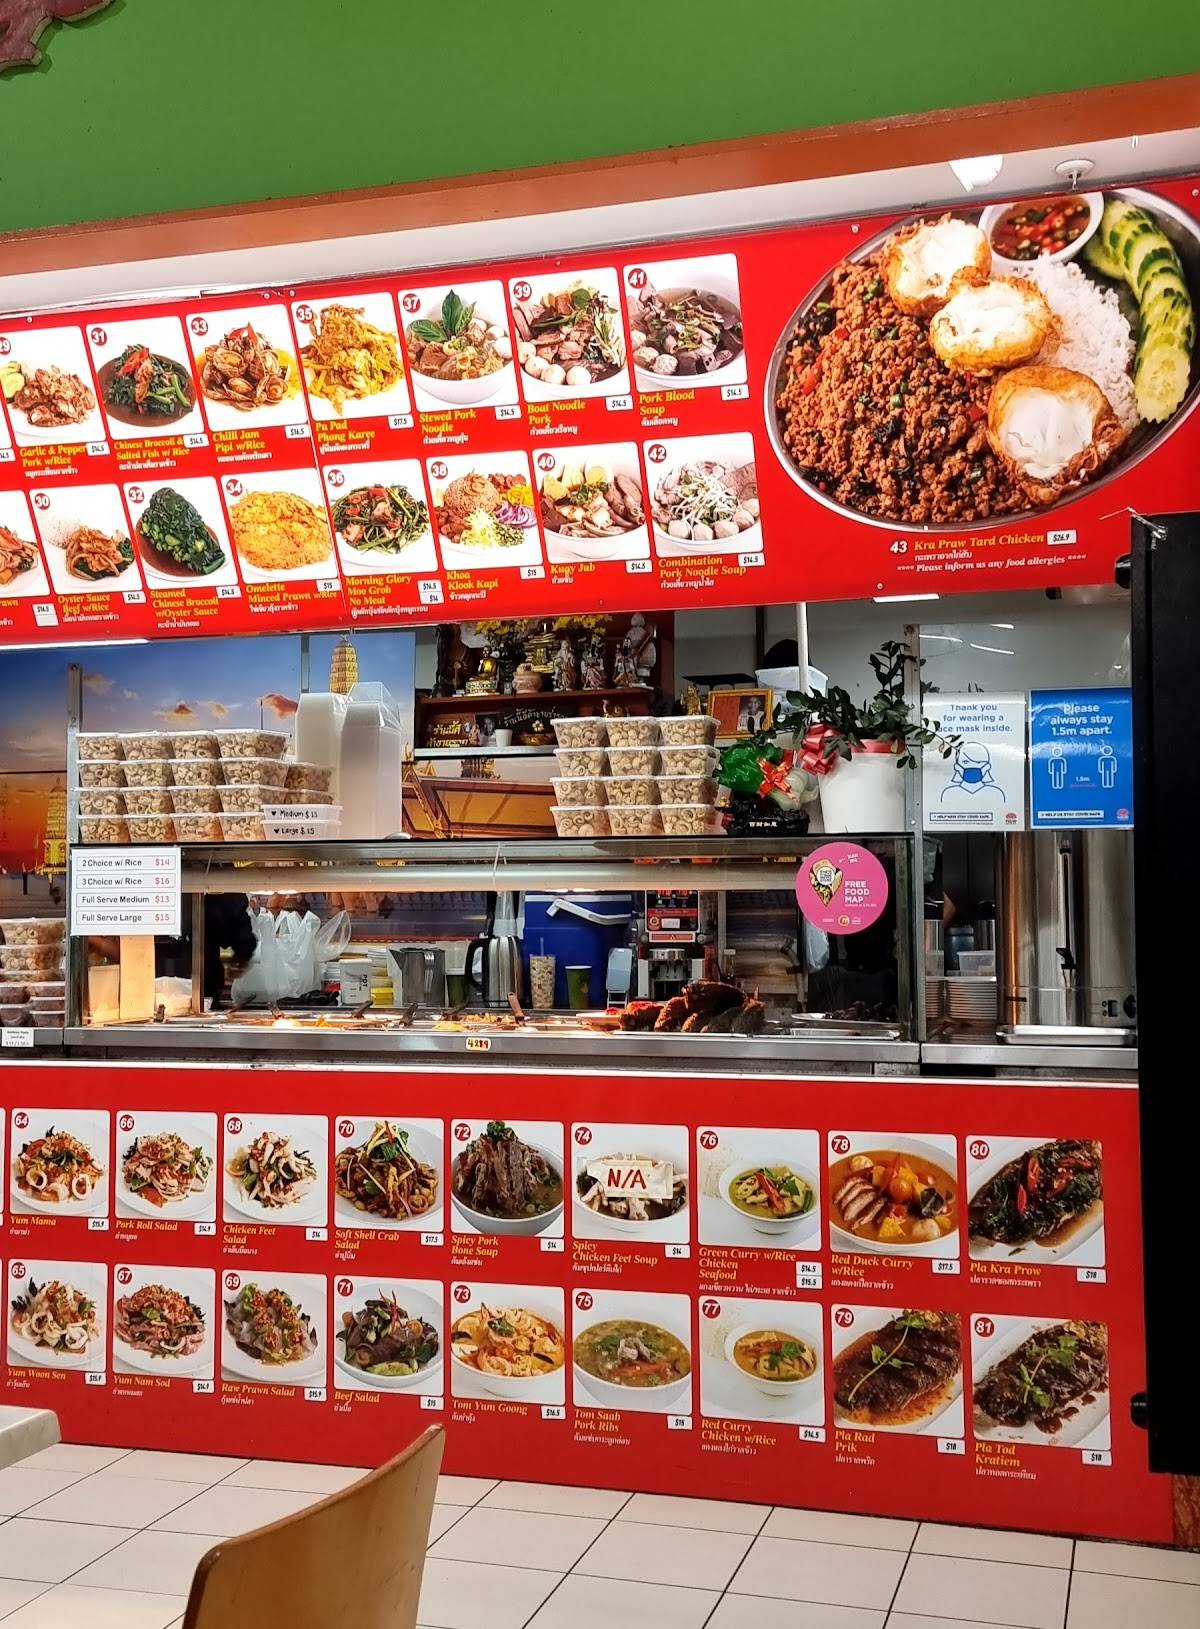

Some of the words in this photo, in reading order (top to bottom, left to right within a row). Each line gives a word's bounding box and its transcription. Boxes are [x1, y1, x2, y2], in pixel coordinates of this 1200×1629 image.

[628, 272, 644, 284] 41
[514, 285, 531, 297] 39
[403, 297, 420, 310] 37
[297, 308, 312, 321] 35
[193, 321, 207, 332] 33
[92, 331, 105, 342] 31
[639, 392, 663, 403] Pork
[665, 390, 695, 401] Blood
[528, 403, 551, 413] Boat
[552, 400, 586, 411] Noodle
[640, 405, 665, 416] Soup
[420, 413, 451, 423] Stewed
[454, 410, 476, 420] Pork
[529, 415, 552, 425] Pork
[316, 422, 327, 432] Pu
[330, 420, 347, 430] Pad
[422, 424, 453, 434] Noodle
[212, 431, 236, 442] Chilli
[239, 429, 260, 440] Jam
[318, 432, 346, 443] Phong
[348, 430, 375, 441] Karee
[215, 443, 233, 453] Pipi
[236, 440, 265, 450] w/Rice
[649, 446, 665, 459] 42
[538, 457, 554, 468] 40
[432, 465, 447, 475] 38
[329, 473, 343, 484] 36
[227, 482, 242, 493] 34
[129, 490, 144, 500] 32
[36, 497, 49, 507] 30
[890, 541, 908, 553] 43
[914, 540, 936, 551] Kra
[938, 539, 966, 549] Praw
[970, 537, 996, 547] Tard
[999, 534, 1044, 545] Chicken
[659, 556, 723, 568] Combination
[916, 563, 942, 572] Please
[945, 561, 974, 571] inform
[988, 560, 1003, 569] any
[1006, 558, 1025, 568] food
[1027, 555, 1065, 566] allergies
[660, 569, 682, 578] Pork
[685, 568, 718, 577] Noodle
[721, 565, 746, 576] Soup
[346, 577, 384, 587] Morning
[386, 575, 411, 586] Glory
[1063, 704, 1099, 714] Please
[958, 714, 996, 723] wearing
[1051, 715, 1087, 725] always
[1090, 715, 1113, 724] stay
[956, 724, 980, 732] mask
[983, 724, 1013, 732] inside.
[1052, 726, 1077, 735] 1.5m
[1080, 726, 1112, 736] apart.
[281, 827, 298, 835] Large
[87, 859, 113, 867] Choice
[115, 859, 123, 867] w/
[125, 859, 142, 867] Rice
[87, 877, 113, 886] Choice
[115, 877, 123, 885] w/
[125, 877, 142, 885] Rice
[154, 877, 170, 885] $16
[155, 895, 170, 903] $13
[82, 914, 95, 922] Full
[97, 914, 117, 922] Serve
[119, 914, 142, 923] Large
[155, 914, 170, 922] $15
[15, 1116, 28, 1125] 64
[120, 1119, 134, 1128] 66
[228, 1121, 241, 1131] 68
[339, 1125, 354, 1133] 70
[456, 1128, 470, 1137] 72
[575, 1131, 591, 1141] 74
[701, 1135, 717, 1146] 76
[832, 1139, 849, 1150] 78
[971, 1145, 988, 1156] 80
[607, 1169, 647, 1190] N/A
[115, 1221, 132, 1229] Pork
[134, 1222, 152, 1230] Roll
[155, 1222, 178, 1231] Salad
[451, 1235, 476, 1247] Spicy
[478, 1236, 499, 1246] Pork
[572, 1241, 598, 1252] Spicy
[451, 1246, 474, 1255] Bone
[476, 1247, 498, 1258] Soup
[699, 1248, 728, 1258] Green
[731, 1250, 760, 1261] Curry
[763, 1251, 796, 1262] w/Rice
[572, 1252, 610, 1262] Chicken
[613, 1254, 632, 1262] Feet
[634, 1255, 658, 1265] Soup
[699, 1259, 738, 1269] Chicken
[832, 1255, 850, 1264] Red
[853, 1256, 879, 1266] Duck
[882, 1257, 914, 1269] Curry
[12, 1266, 25, 1275] 65
[832, 1267, 864, 1276] w/Rice
[970, 1263, 987, 1273] Pla
[990, 1264, 1011, 1274] Kra
[1015, 1265, 1041, 1275] Prow
[118, 1271, 131, 1280] 67
[699, 1270, 737, 1280] Seafood
[226, 1277, 239, 1286] 69
[338, 1283, 352, 1292] 71
[455, 1289, 470, 1299] 73
[577, 1296, 592, 1307] 75
[703, 1303, 720, 1315] 77
[836, 1312, 853, 1324] 79
[976, 1322, 992, 1333] 81
[335, 1392, 353, 1403] Beef
[355, 1394, 379, 1402] Salad
[452, 1401, 472, 1410] Tom
[474, 1402, 495, 1412] Yum
[498, 1404, 528, 1415] Goong
[702, 1420, 720, 1430] Red
[723, 1421, 752, 1432] Curry
[702, 1431, 741, 1442] Chicken
[744, 1433, 777, 1445] w/Rice
[836, 1431, 853, 1441] Pla
[855, 1433, 875, 1443] Rad
[836, 1441, 858, 1453] Prik
[976, 1443, 992, 1453] Pla
[997, 1444, 1016, 1454] Tod
[976, 1454, 1020, 1467] Kratiem
